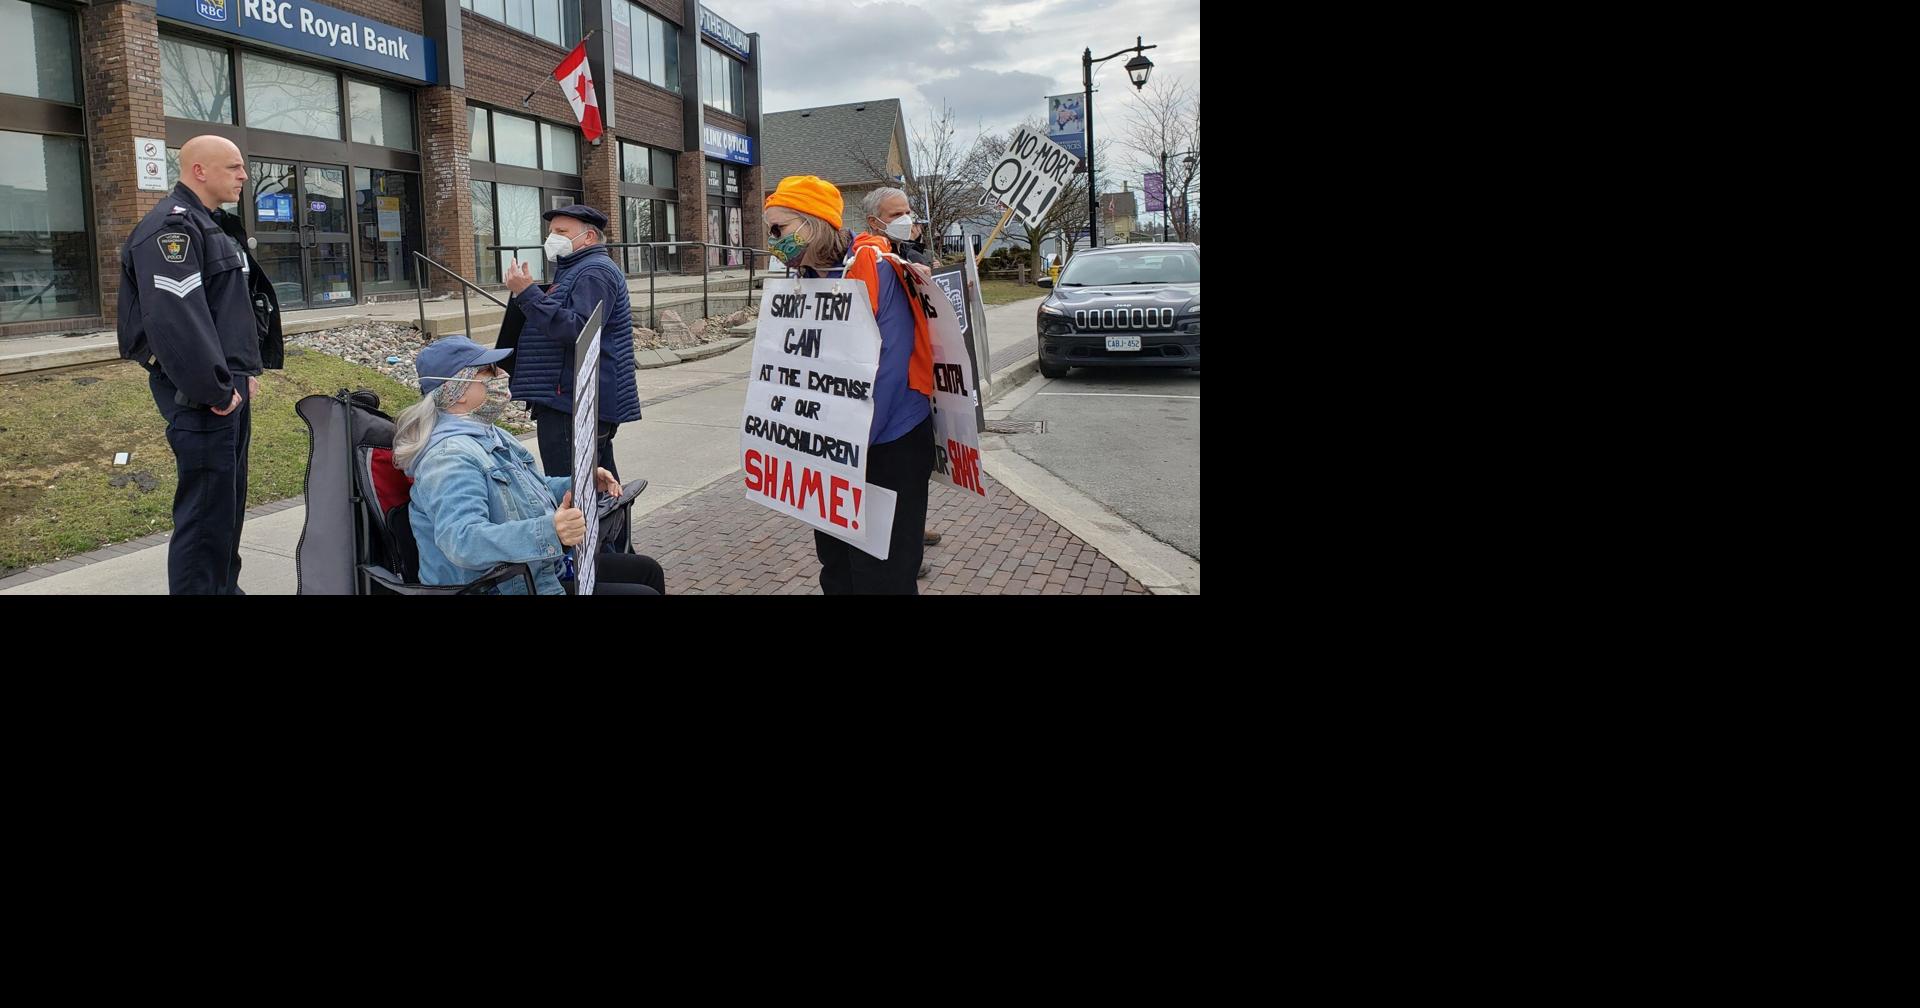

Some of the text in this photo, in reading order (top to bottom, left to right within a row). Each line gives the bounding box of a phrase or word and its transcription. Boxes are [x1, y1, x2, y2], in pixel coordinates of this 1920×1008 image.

[200, 4, 224, 18] RBC
[244, 0, 410, 61] RBC Royal Bank
[1009, 128, 1076, 187] NO MORE
[759, 364, 871, 401] AT THE EXPENSE
[933, 362, 968, 397] ENTAL
[770, 395, 821, 421] OF OUR
[744, 414, 860, 469] GRANDCHILDREN
[744, 448, 863, 530] SHAME!
